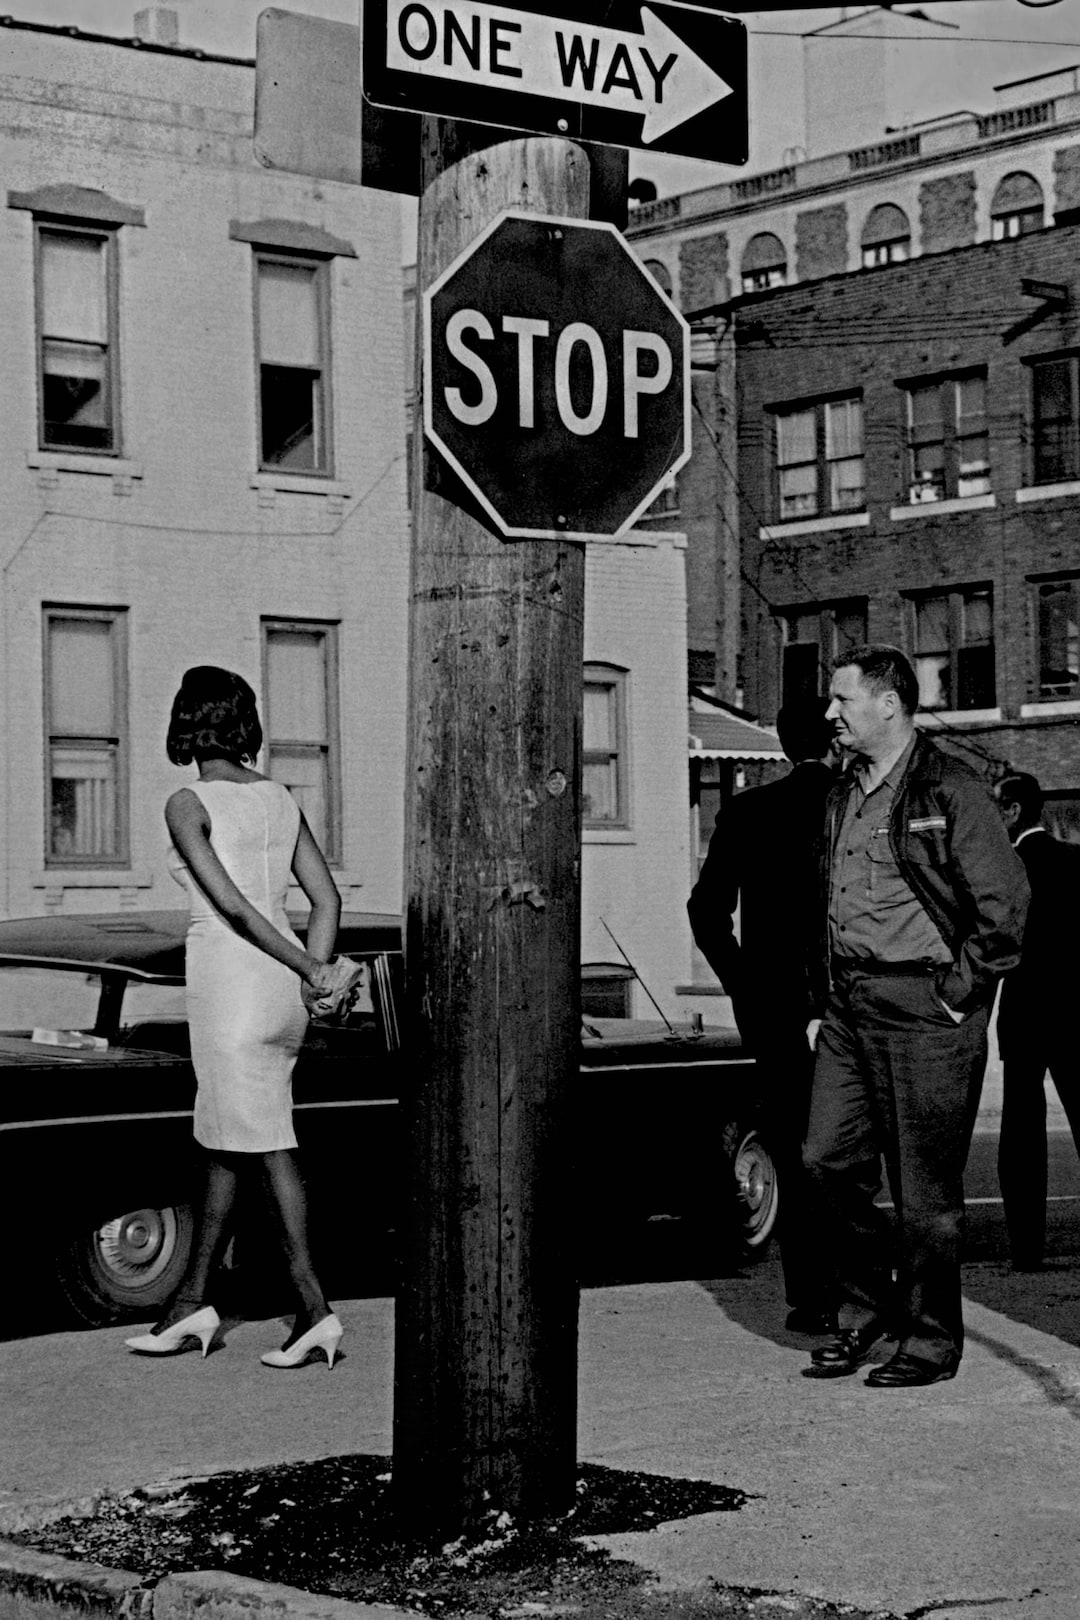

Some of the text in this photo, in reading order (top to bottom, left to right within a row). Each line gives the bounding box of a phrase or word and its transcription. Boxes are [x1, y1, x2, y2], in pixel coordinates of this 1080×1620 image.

[398, 3, 679, 104] ONE WAY
[444, 308, 673, 439] STOP
